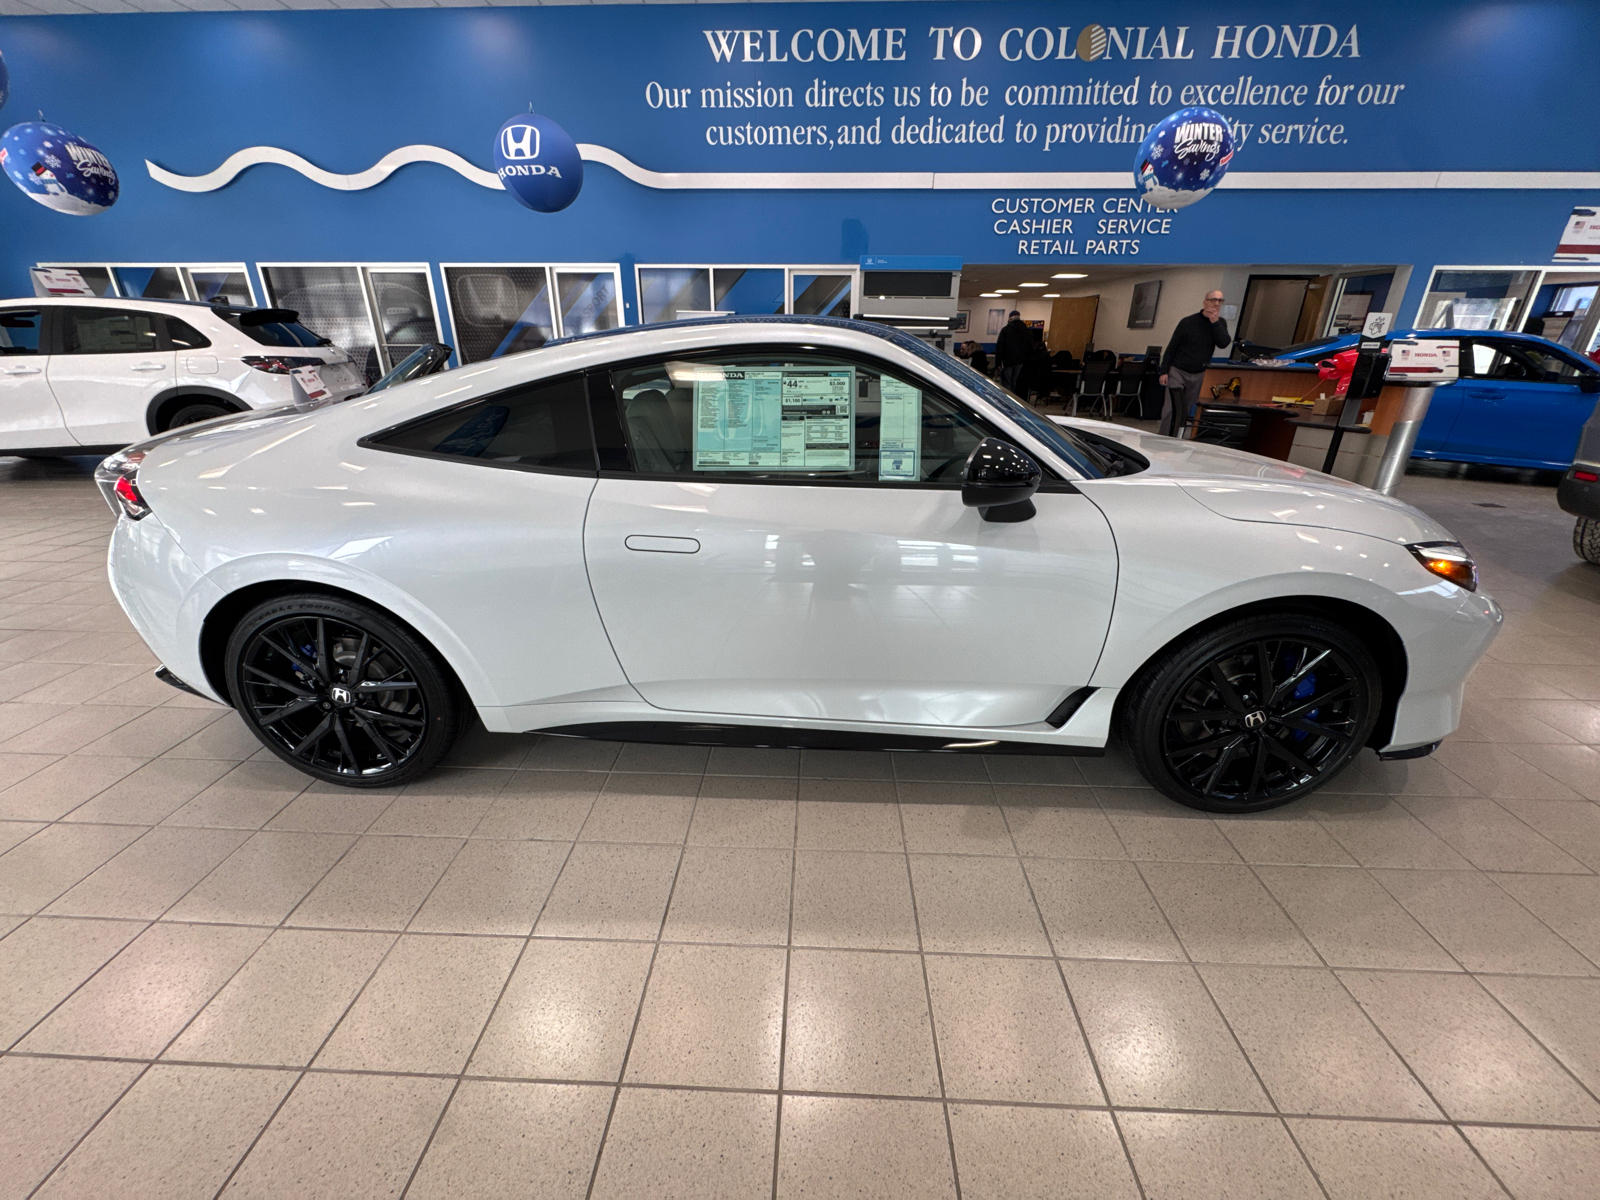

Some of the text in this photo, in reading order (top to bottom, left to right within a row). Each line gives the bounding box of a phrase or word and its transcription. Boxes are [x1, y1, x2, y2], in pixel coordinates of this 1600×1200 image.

[703, 28, 906, 63] WELCOME
[928, 26, 982, 61] TO
[1210, 24, 1361, 60] HONDA
[645, 75, 1405, 109] Our mission directs us to be committed to excellence for our
[890, 115, 1005, 145] dedicated
[1014, 119, 1038, 144] to
[1257, 118, 1349, 146] service.
[1174, 121, 1223, 144] WINTER
[1173, 138, 1221, 162] Savings
[497, 164, 563, 181] HONDA
[991, 198, 1179, 214] CUSTOMER CEN
[993, 219, 1172, 235] CASHIER SERVICE
[1018, 240, 1141, 255] RETAIL PARTS
